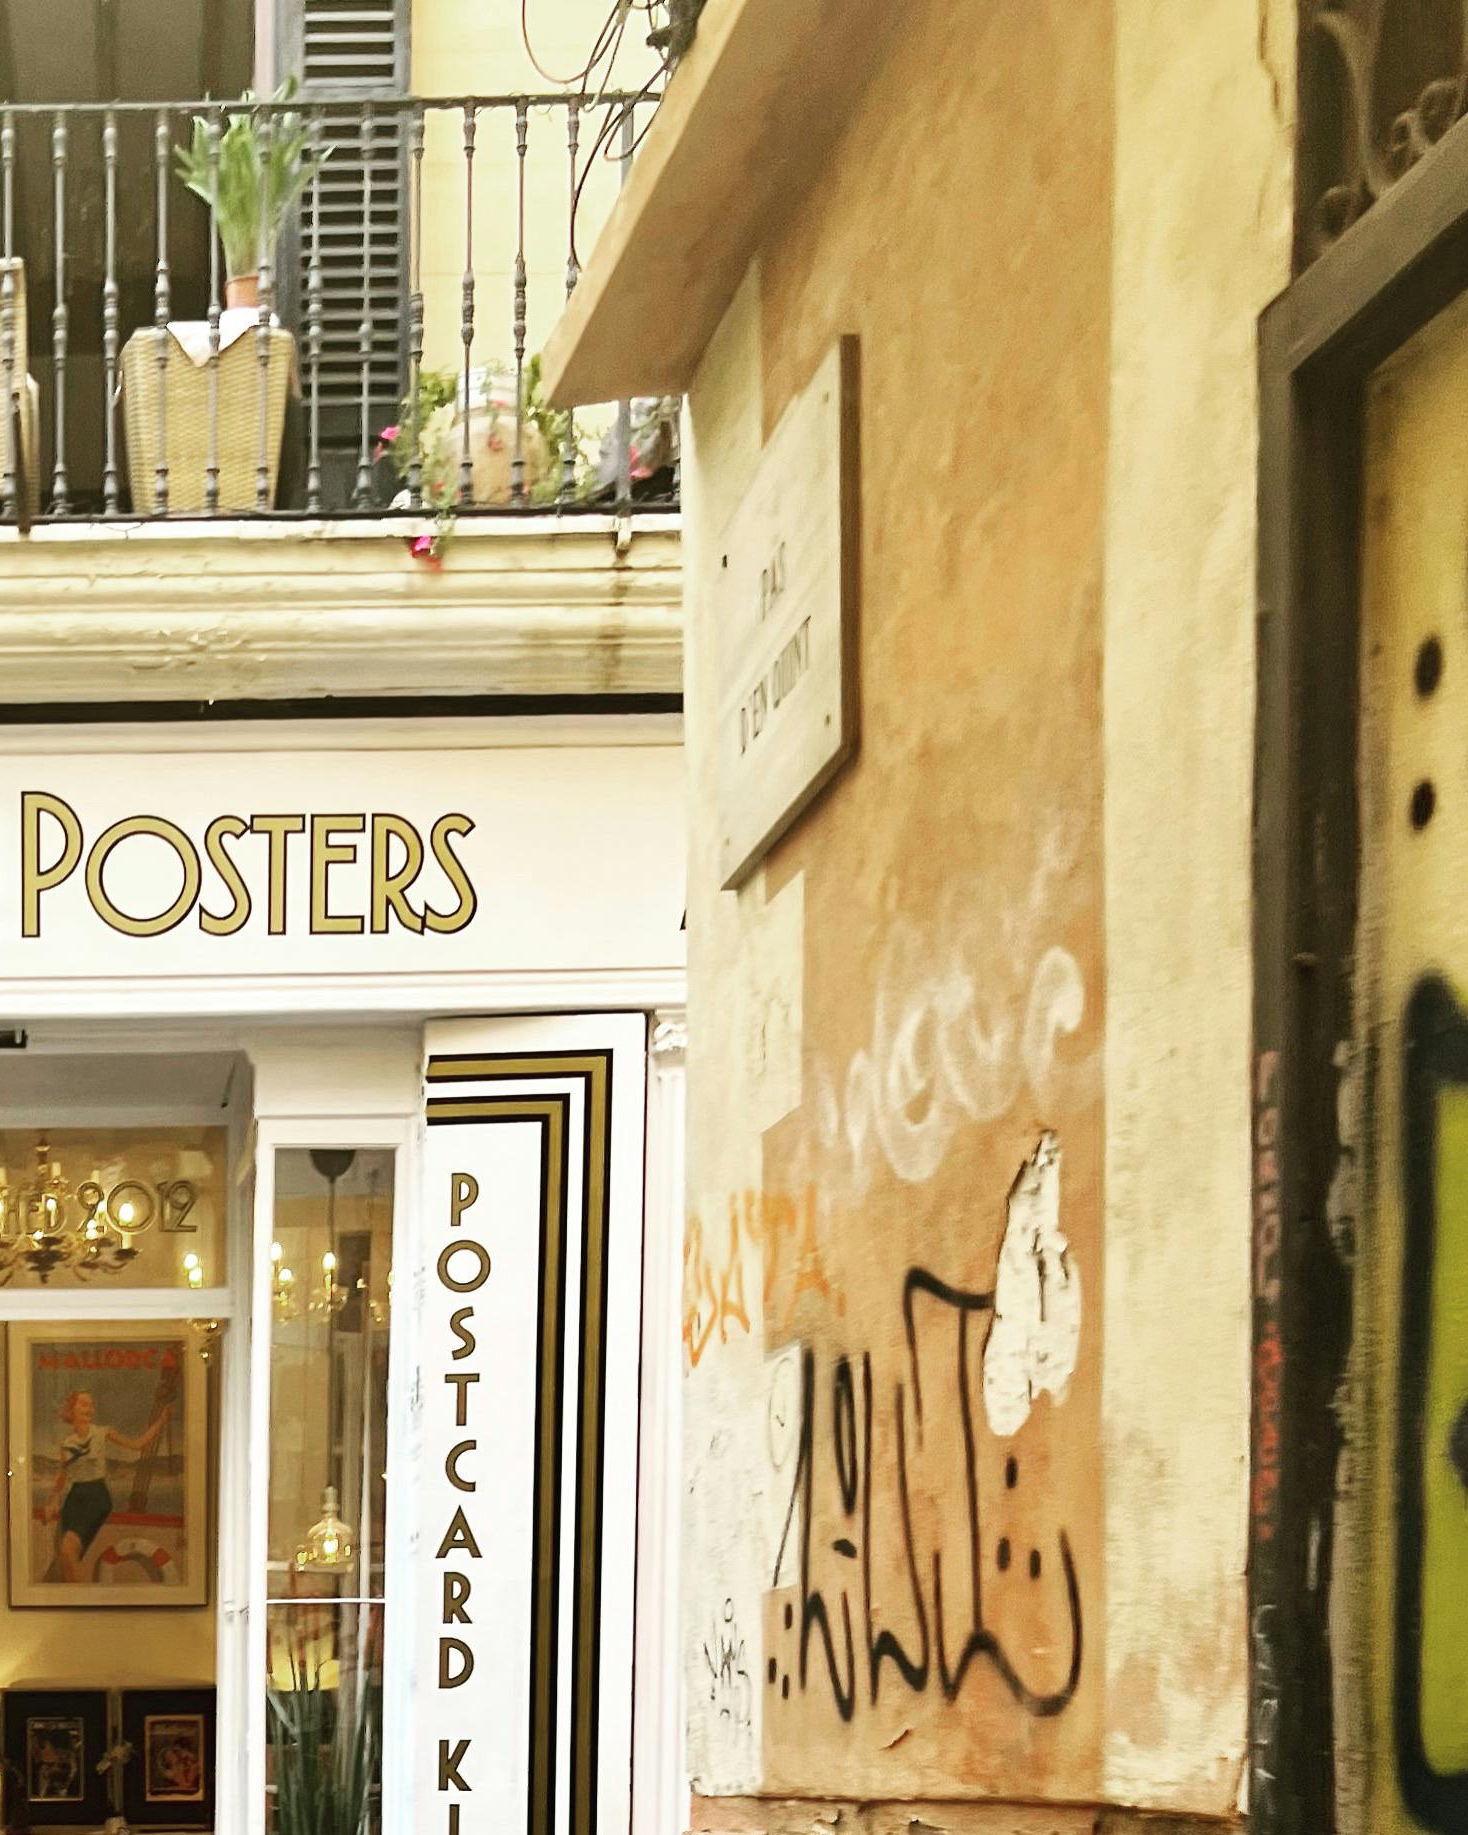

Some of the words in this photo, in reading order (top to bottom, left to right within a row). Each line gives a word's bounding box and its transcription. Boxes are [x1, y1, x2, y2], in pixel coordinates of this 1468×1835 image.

[20, 790, 479, 938] POSTERS
[77, 1180, 198, 1236] 2012
[435, 1172, 492, 1690] POSTCARD
